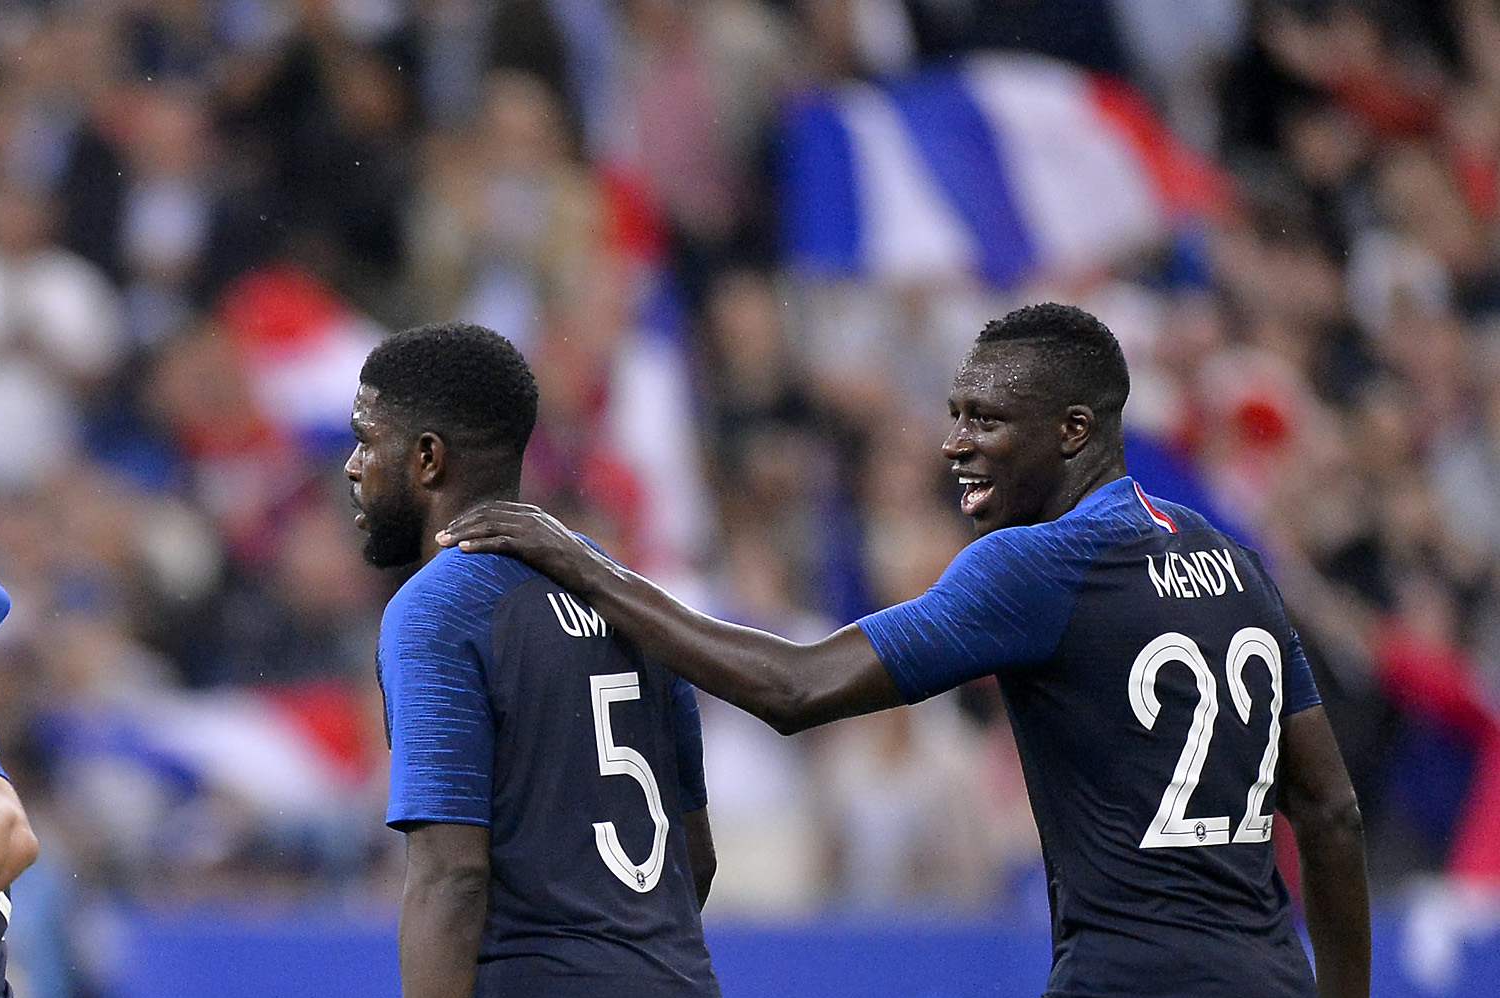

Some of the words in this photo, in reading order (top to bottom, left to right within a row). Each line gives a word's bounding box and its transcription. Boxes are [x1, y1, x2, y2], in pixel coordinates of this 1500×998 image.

[546, 592, 614, 638] UM
[1145, 548, 1244, 598] MENDY
[589, 671, 669, 893] 5
[1128, 627, 1283, 849] 22
